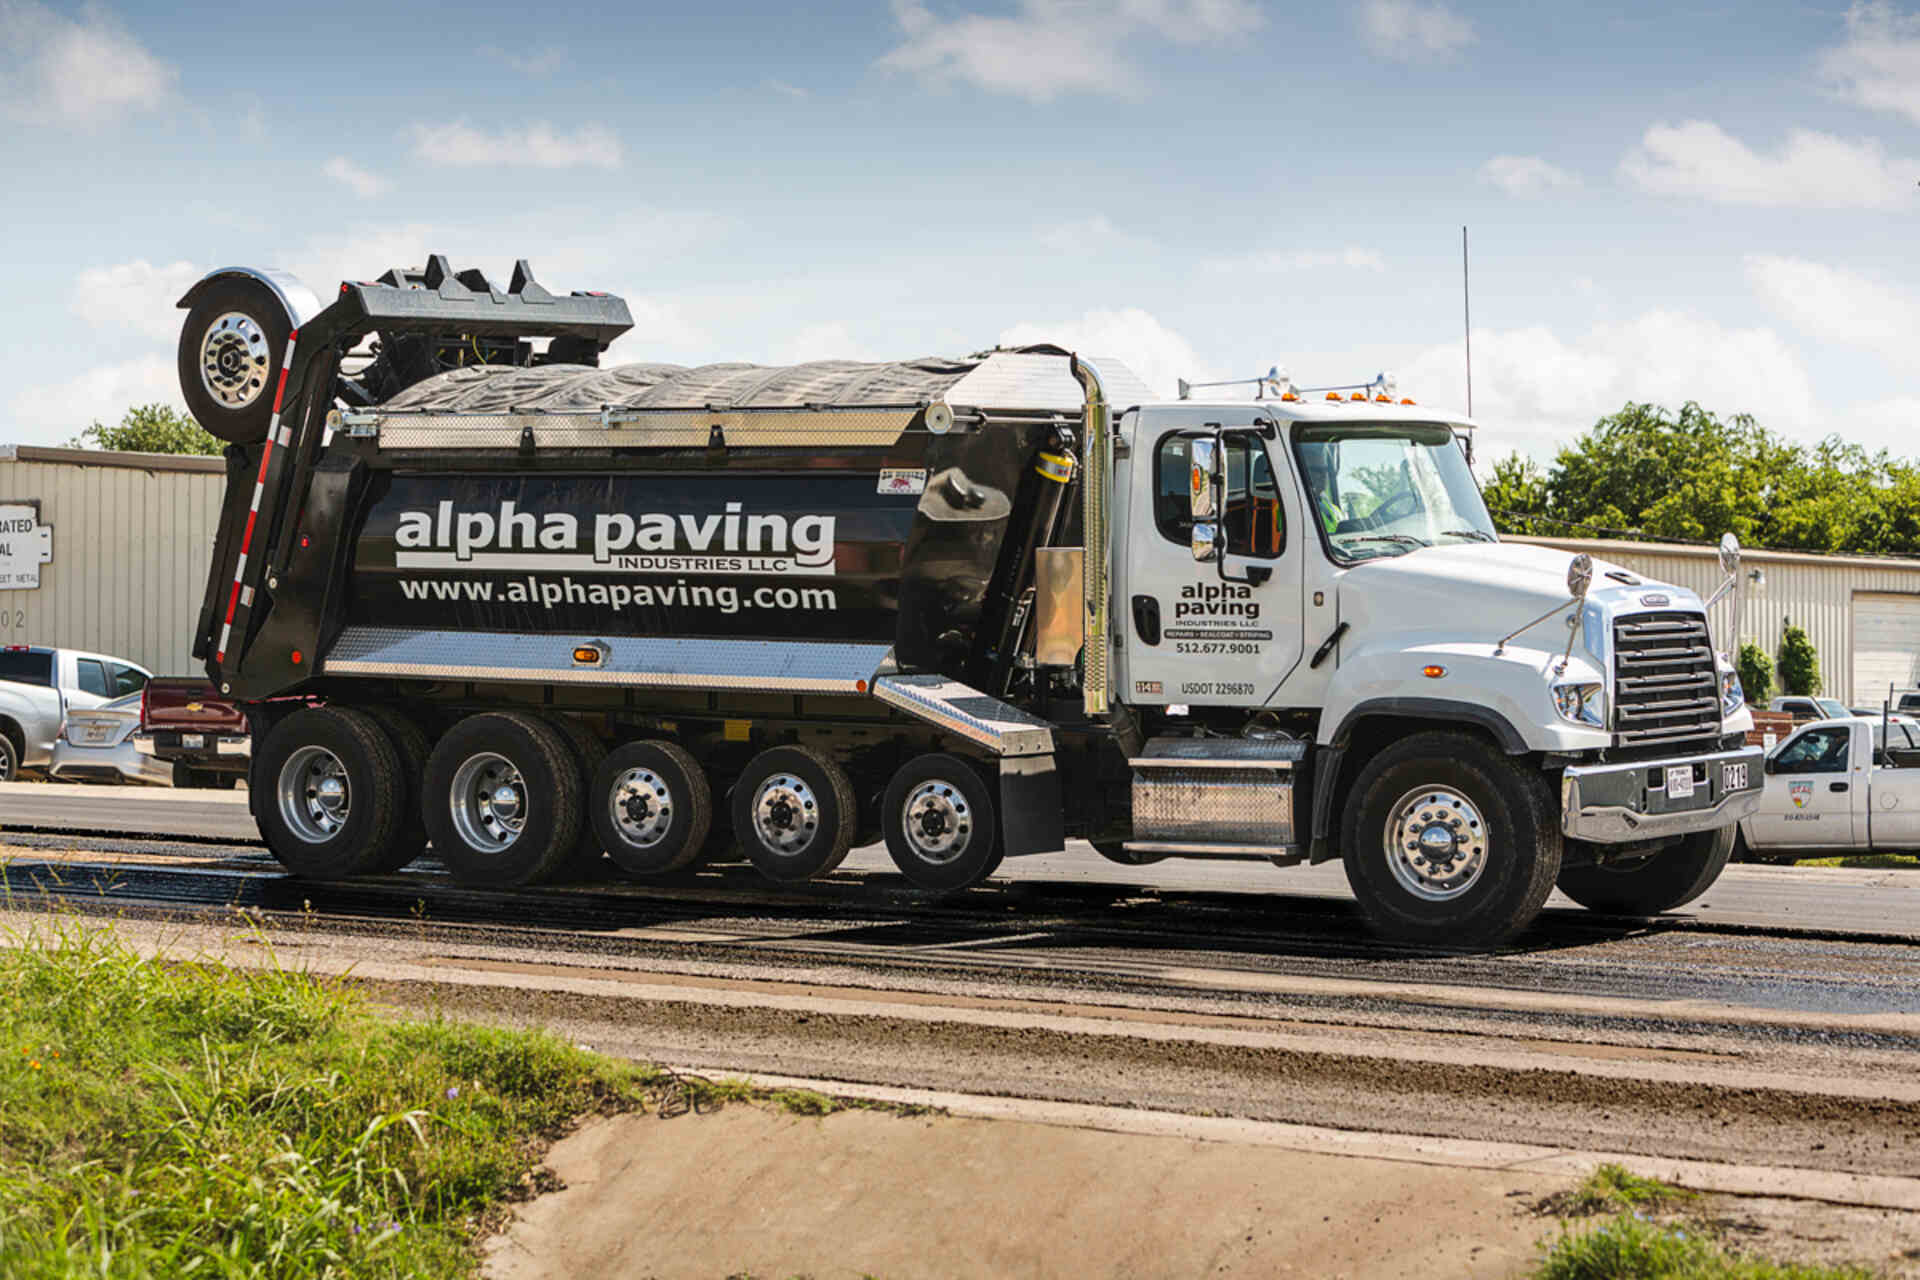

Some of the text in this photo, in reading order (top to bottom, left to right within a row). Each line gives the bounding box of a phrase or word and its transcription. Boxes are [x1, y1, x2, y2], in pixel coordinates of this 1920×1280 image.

[395, 500, 836, 564] alpha paving
[618, 557, 788, 572] INDUSTRIES LLC
[399, 576, 837, 614] www.alphapaving.com
[1182, 582, 1251, 602] alpha
[1175, 599, 1260, 619] paving
[1240, 620, 1259, 628] LLC
[1176, 642, 1260, 654] 512.677.9001
[1181, 683, 1255, 695] USDOT 2296870
